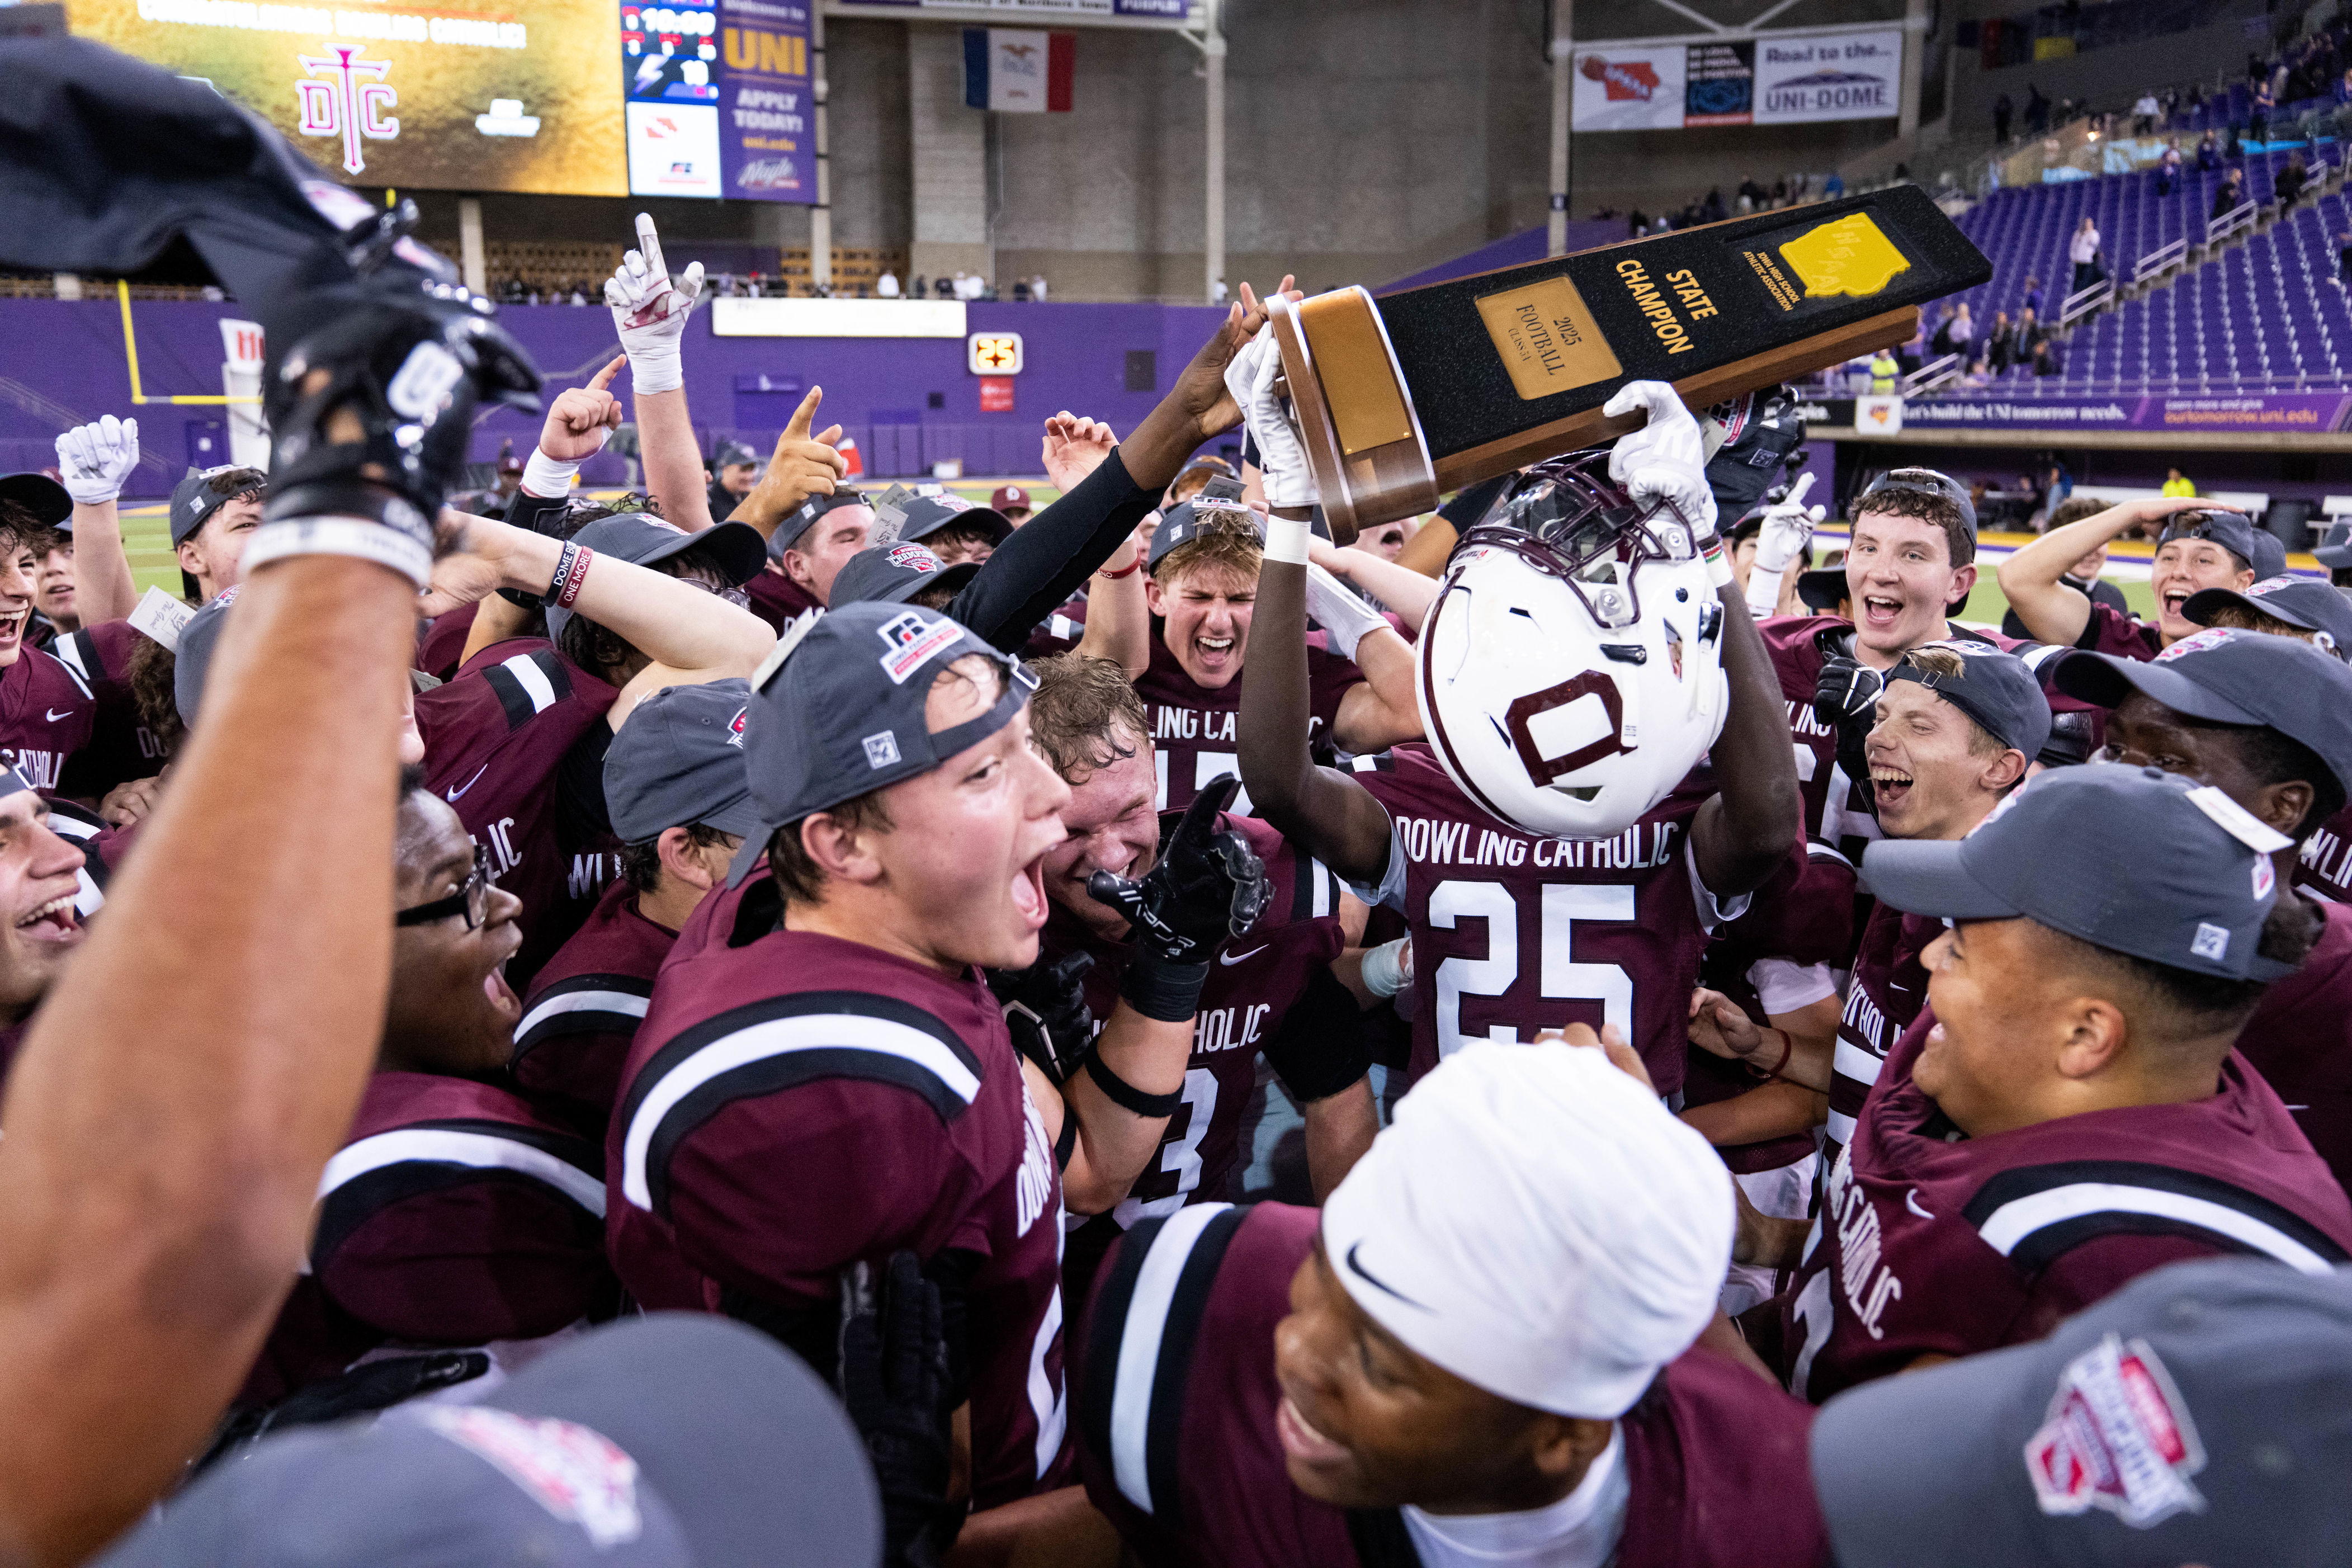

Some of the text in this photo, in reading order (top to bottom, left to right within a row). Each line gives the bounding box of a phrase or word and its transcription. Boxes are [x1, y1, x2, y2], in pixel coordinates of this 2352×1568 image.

[725, 28, 806, 75] UNI
[1766, 46, 1814, 63] Road
[1819, 47, 1839, 61] to
[737, 88, 798, 112] APPLY
[1766, 86, 1887, 111] UNI-DOME
[1666, 269, 1718, 321] STATE
[1742, 251, 1793, 311] ATHLETIC ASSOCIATION
[1757, 252, 1800, 304] IOWA HIGH SCHOOL
[1553, 317, 1582, 346] 2025
[1616, 259, 1694, 355] CHAMPION
[976, 338, 1016, 369] 25
[1517, 304, 1566, 375] FOOTBALL
[554, 554, 573, 586] DOME
[564, 553, 591, 602] ONE MORE
[1505, 669, 1638, 788] D
[1396, 816, 1679, 869] DOWLING CATHOLIC
[1429, 880, 1636, 1064] 25
